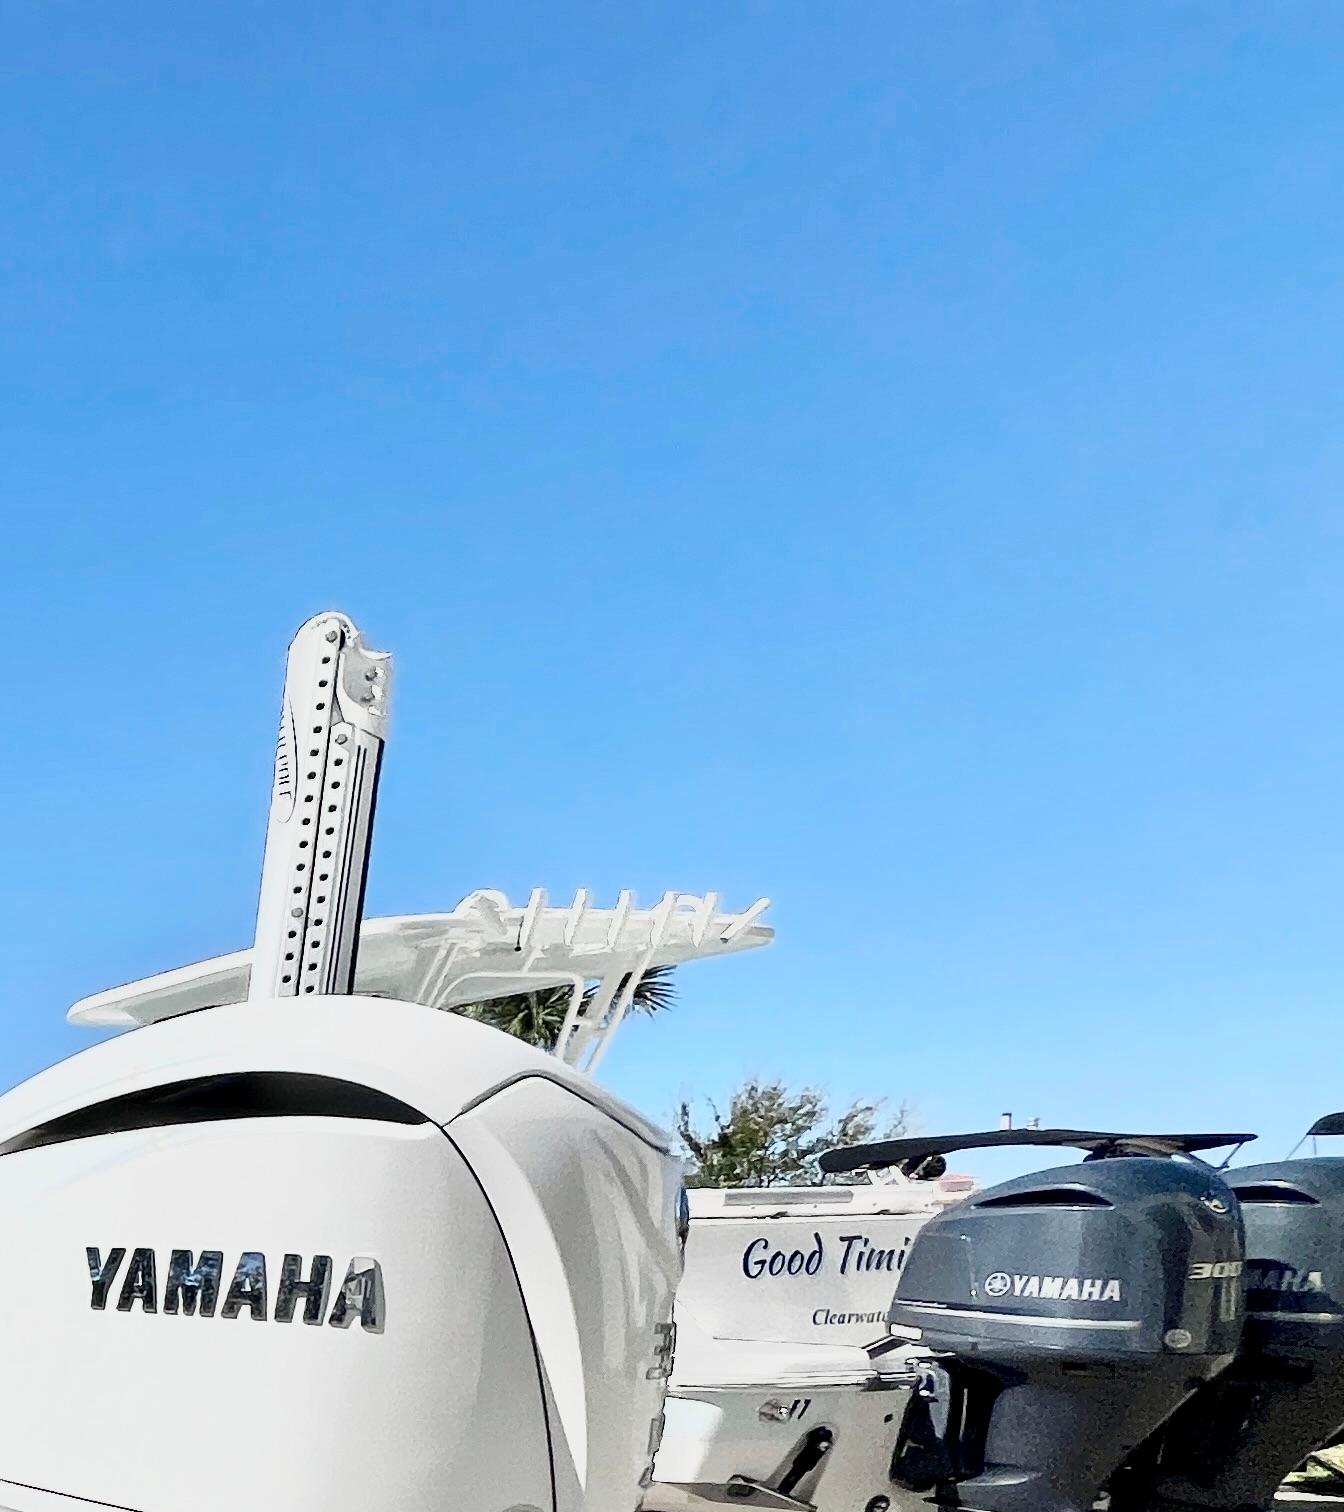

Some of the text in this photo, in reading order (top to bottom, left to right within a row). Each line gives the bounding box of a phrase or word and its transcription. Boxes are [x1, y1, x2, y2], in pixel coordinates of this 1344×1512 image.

[742, 1232, 823, 1279] Good
[85, 1246, 386, 1334] YAMAHA
[1012, 1273, 1121, 1302] YAMAHA
